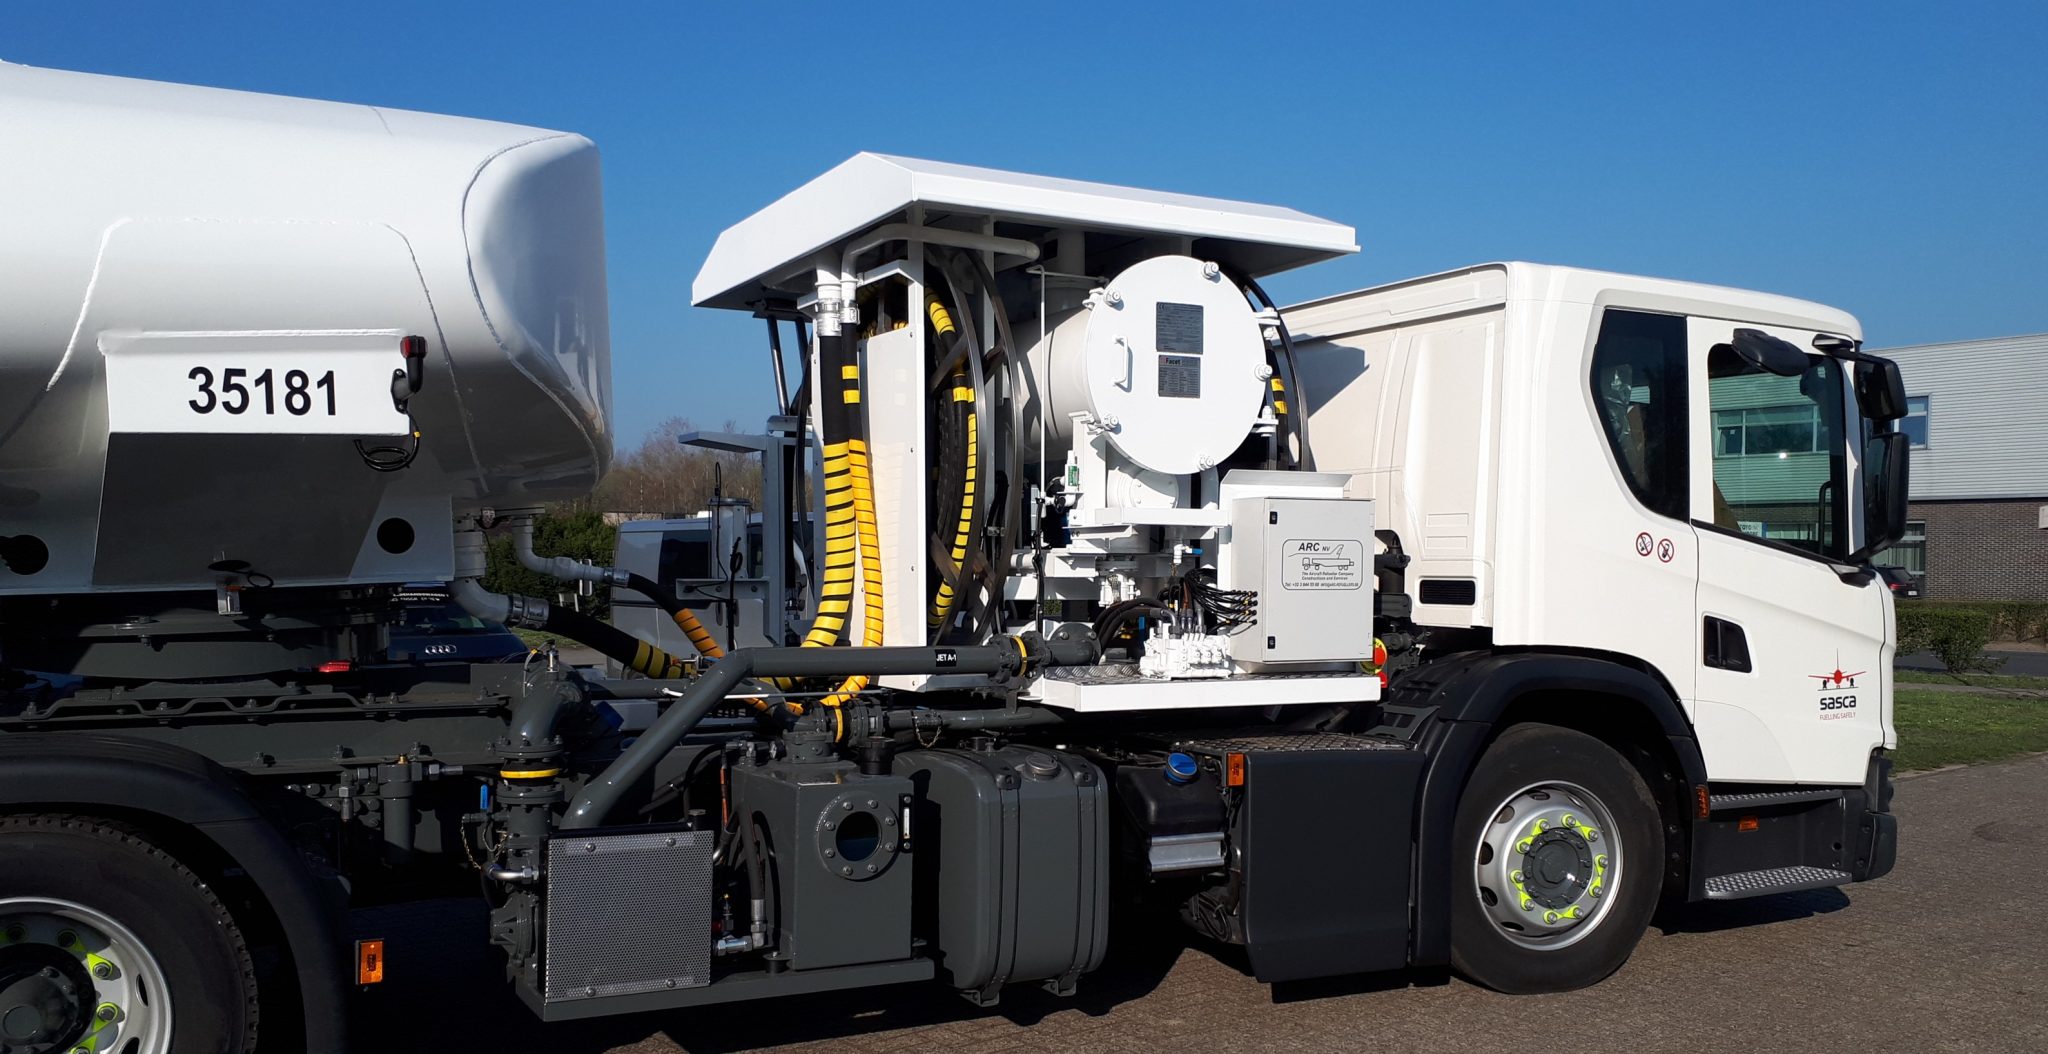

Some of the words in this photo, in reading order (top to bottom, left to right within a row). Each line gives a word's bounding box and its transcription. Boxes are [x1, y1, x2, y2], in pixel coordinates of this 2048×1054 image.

[1165, 357, 1181, 365] Facet
[188, 366, 336, 416] 35181
[1298, 542, 1320, 551] ARC
[936, 653, 946, 662] JET
[947, 653, 957, 662] A-1
[1820, 695, 1857, 710] sasca
